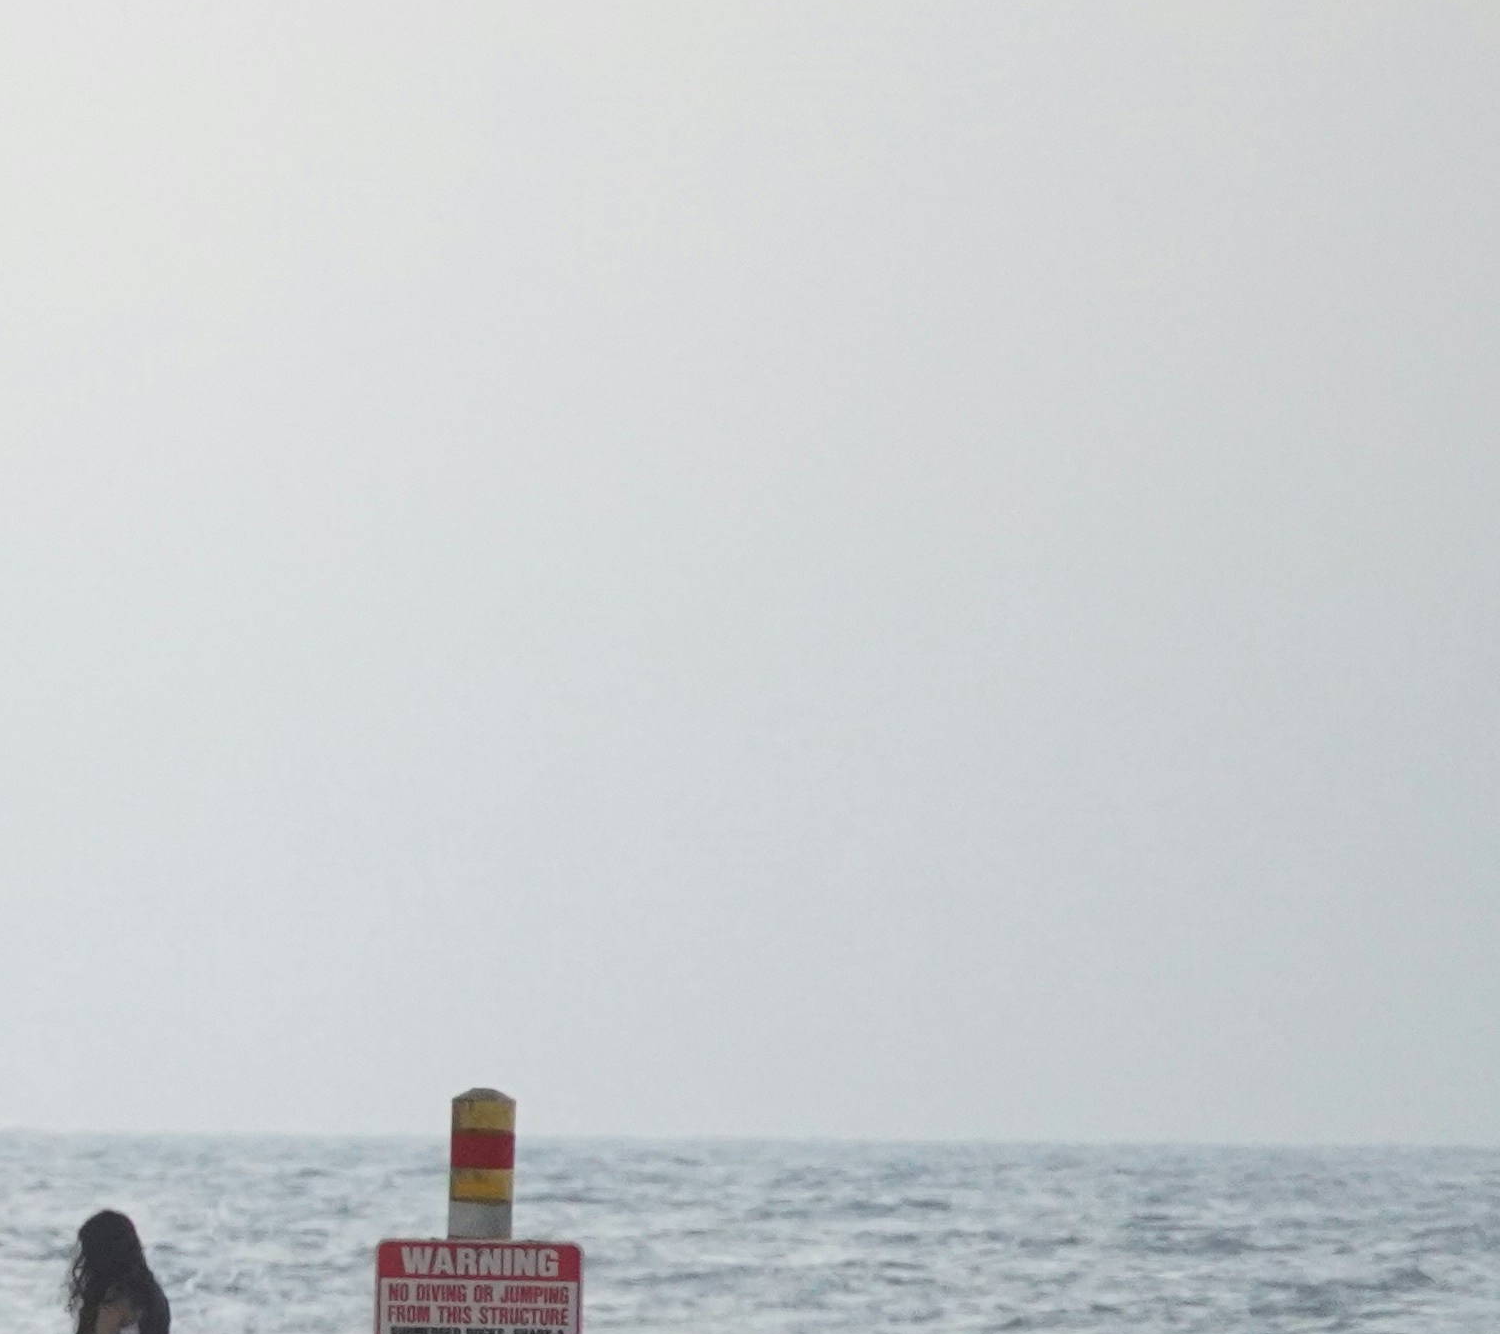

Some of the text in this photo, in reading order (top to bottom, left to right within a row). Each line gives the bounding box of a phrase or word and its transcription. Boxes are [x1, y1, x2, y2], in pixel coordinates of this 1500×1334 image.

[401, 1246, 559, 1277] WARNING
[388, 1283, 569, 1304] NO DIVING OR JUMPING
[388, 1305, 569, 1325] FROM THIS STRUCTURE
